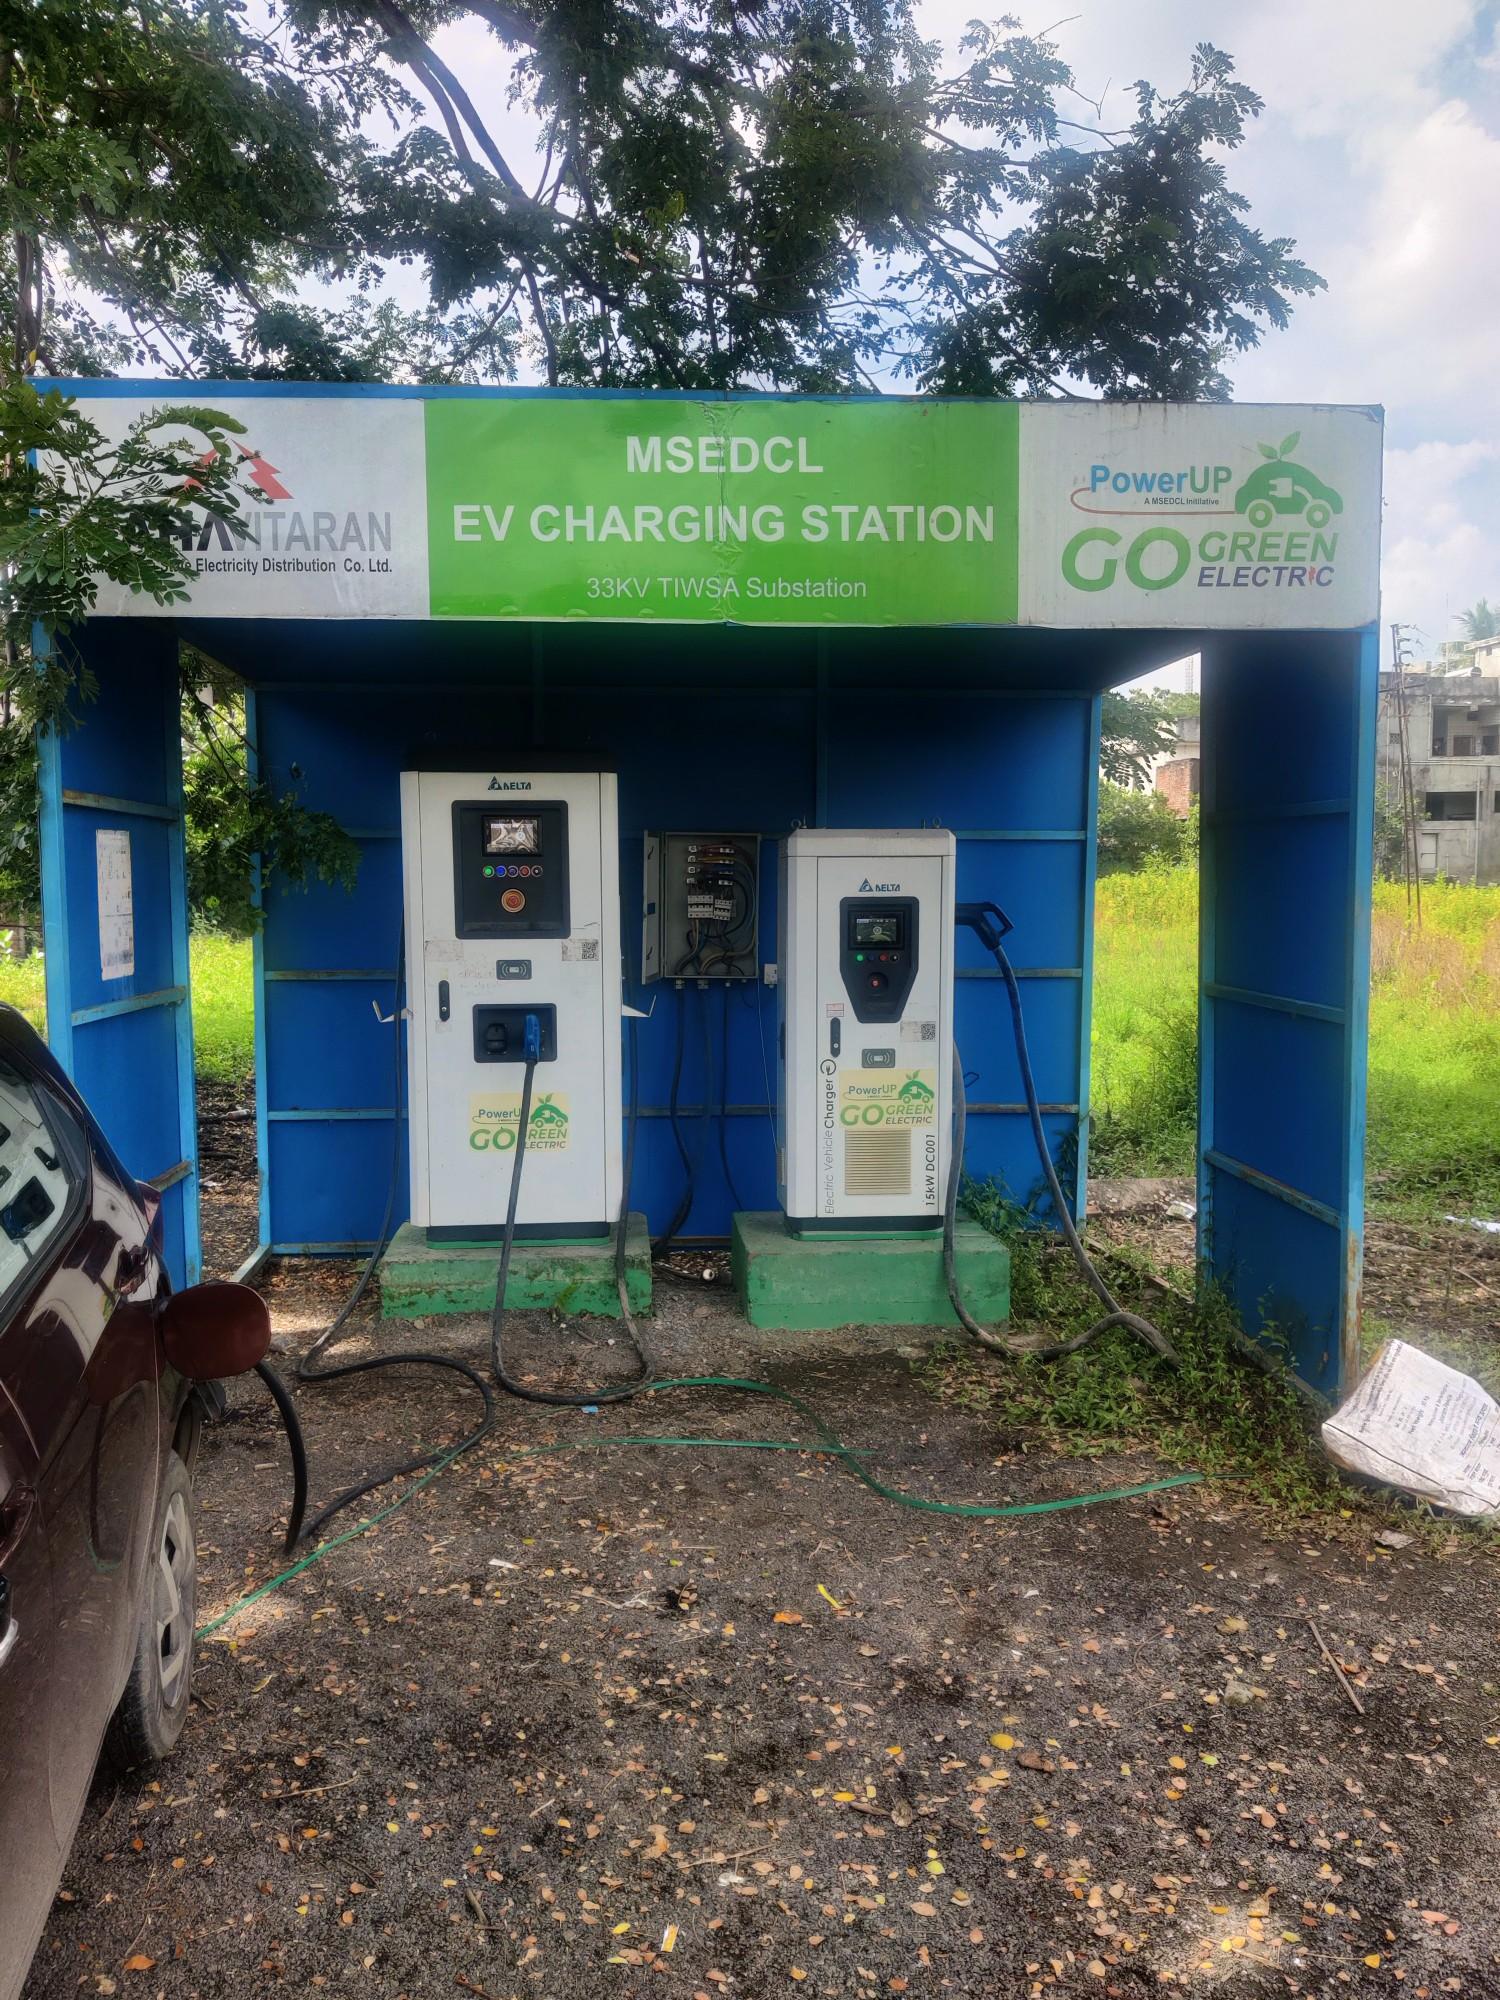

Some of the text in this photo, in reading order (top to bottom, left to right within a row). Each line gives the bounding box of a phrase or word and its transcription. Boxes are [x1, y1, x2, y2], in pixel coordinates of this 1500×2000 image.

[626, 436, 823, 473] MSEDCL
[1090, 465, 1232, 493] PowerUP
[1152, 497, 1185, 505] MSEDCL
[453, 504, 994, 543] EV CHARGING STATION
[196, 558, 258, 575] Electricity
[262, 558, 336, 572] Distribution
[343, 558, 365, 573] Co.
[369, 558, 393, 573] Ltd.
[1061, 527, 1337, 592] GO GREEN
[586, 577, 867, 599] 33KV TIWSA Substation
[1197, 566, 1334, 588] ELECTRIC
[875, 884, 901, 892] DELTA
[848, 1084, 897, 1095] PowerUP
[479, 1107, 525, 1119] PowerU
[840, 1104, 934, 1126] GO GREEN
[885, 1116, 933, 1125] ELECTRIC
[469, 1128, 568, 1150] GO REEN
[520, 1140, 567, 1149] LECTRIC
[823, 1078, 836, 1215] Electric Vehicle Charger
[925, 1134, 936, 1206] 15kW DC001
